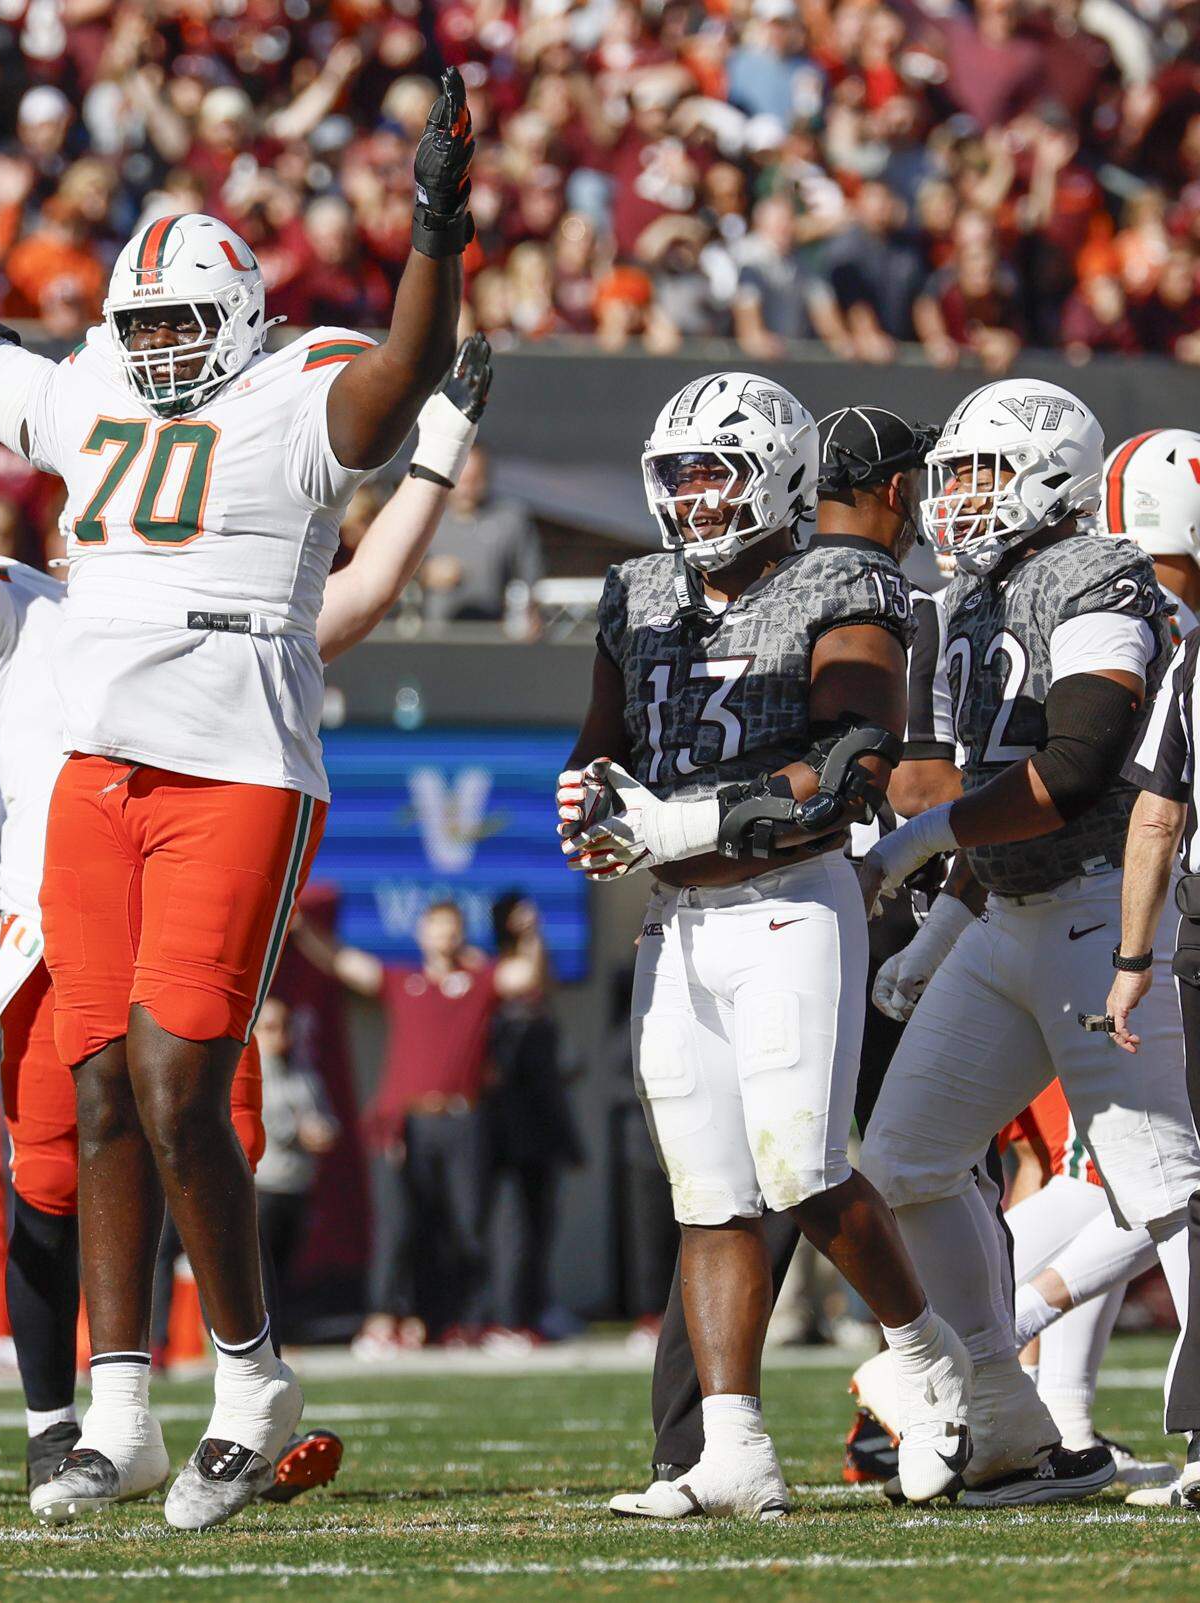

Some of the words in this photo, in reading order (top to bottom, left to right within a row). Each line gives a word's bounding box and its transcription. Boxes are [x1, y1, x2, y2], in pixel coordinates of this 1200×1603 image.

[133, 286, 164, 297] MIAMI
[665, 429, 688, 437] TECH
[999, 396, 1075, 432] VT
[72, 414, 222, 548] 70
[868, 569, 908, 619] 13
[642, 656, 756, 785] 13
[945, 628, 1048, 766] 22
